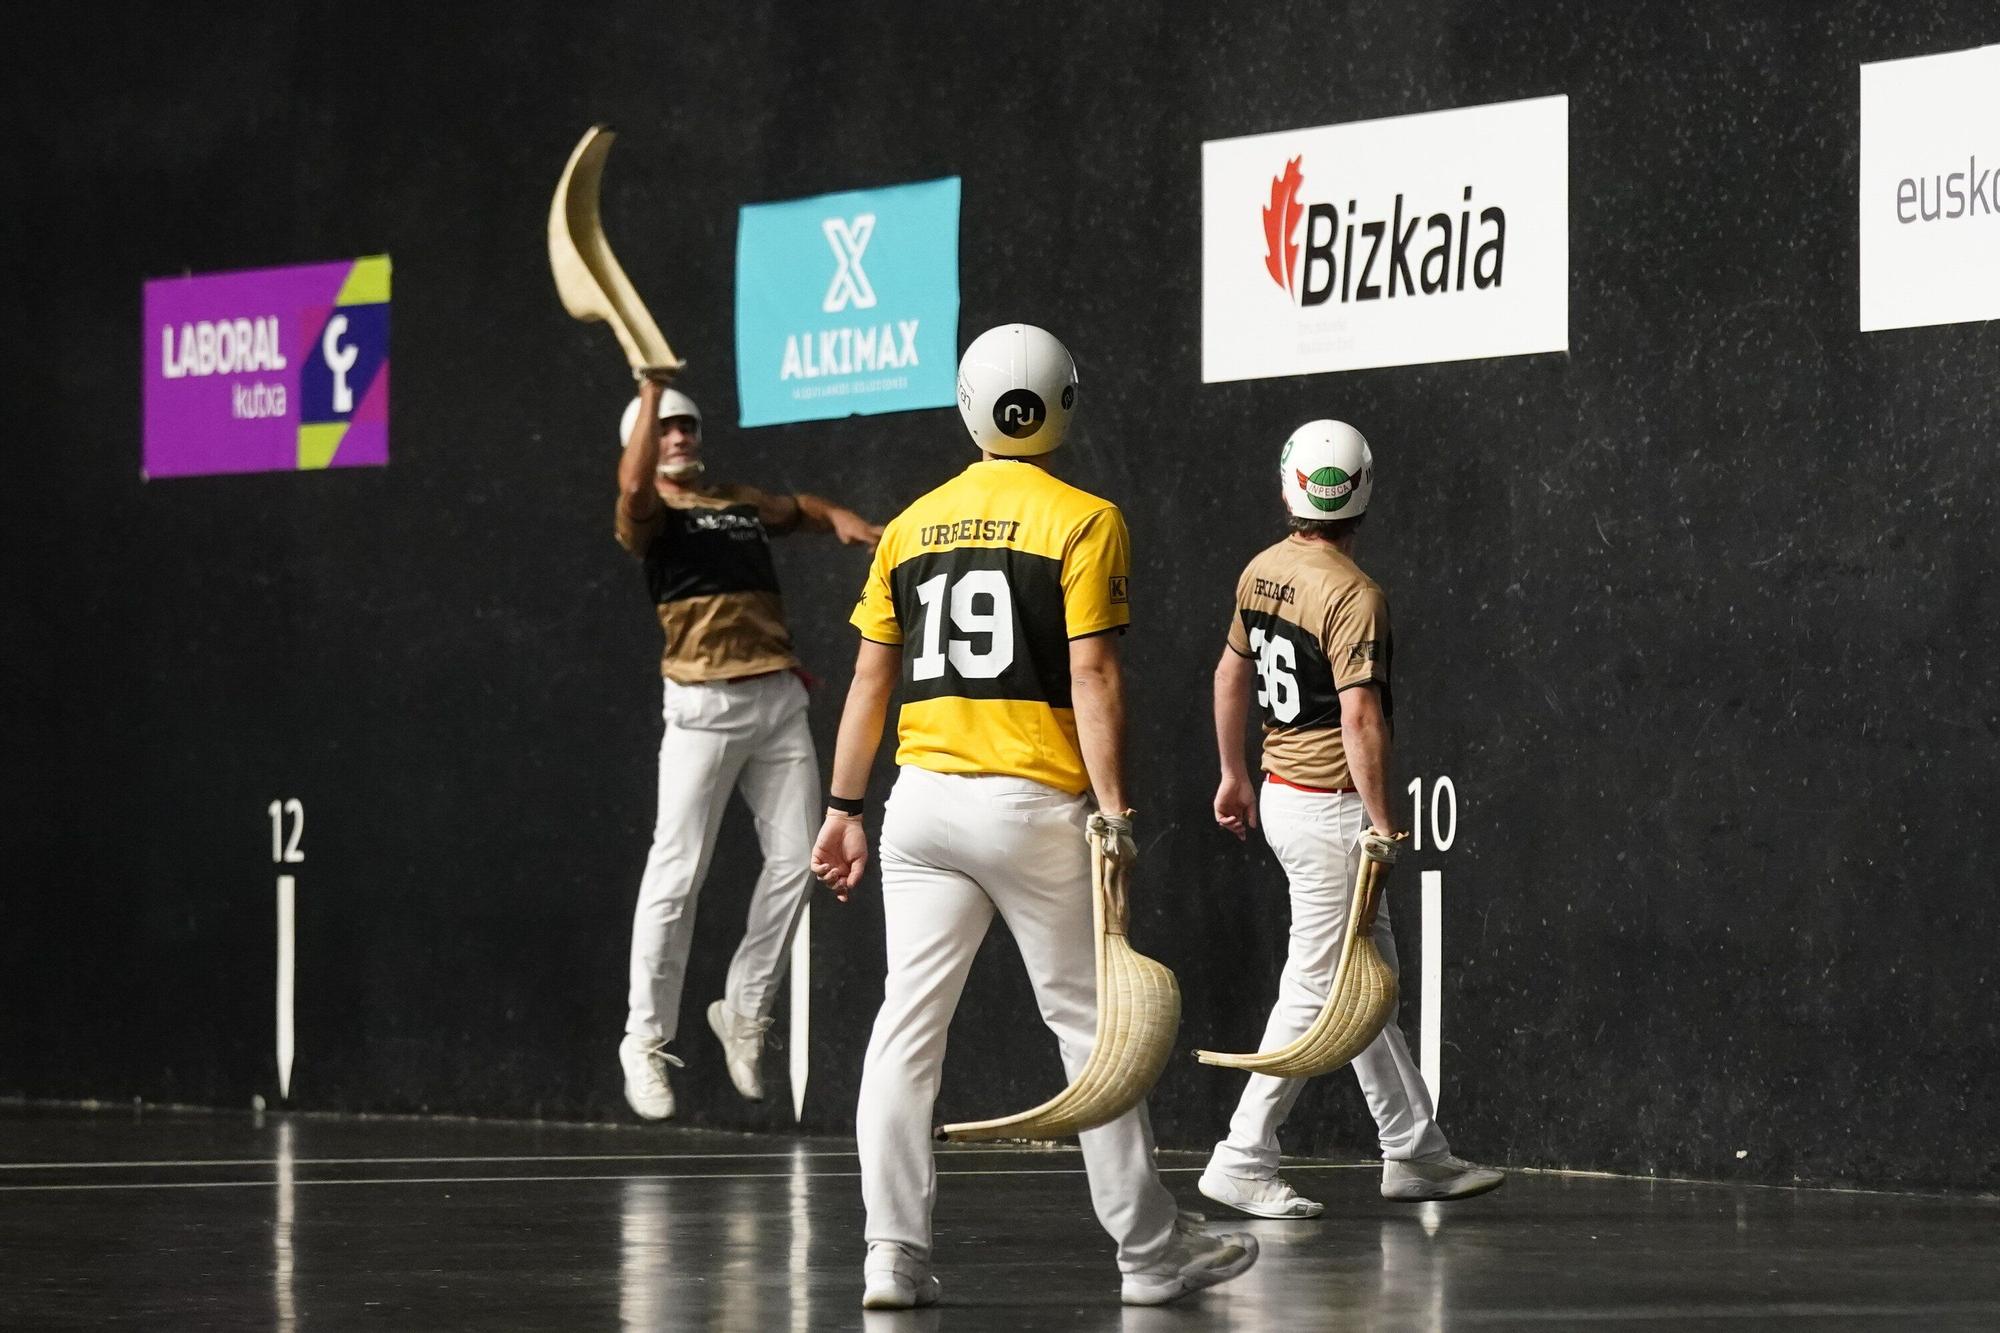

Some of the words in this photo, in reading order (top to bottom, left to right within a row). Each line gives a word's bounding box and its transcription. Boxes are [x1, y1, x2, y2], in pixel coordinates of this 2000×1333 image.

[1301, 185, 1506, 308] Bizkaia
[162, 315, 287, 379] LABORAL
[780, 319, 920, 381] ALKIMAX
[232, 381, 287, 419] kutxa
[1308, 484, 1350, 497] INPESCA
[912, 569, 1014, 682] 19
[1250, 627, 1301, 723] 36
[268, 798, 305, 863] 12
[1407, 775, 1457, 852] 10
